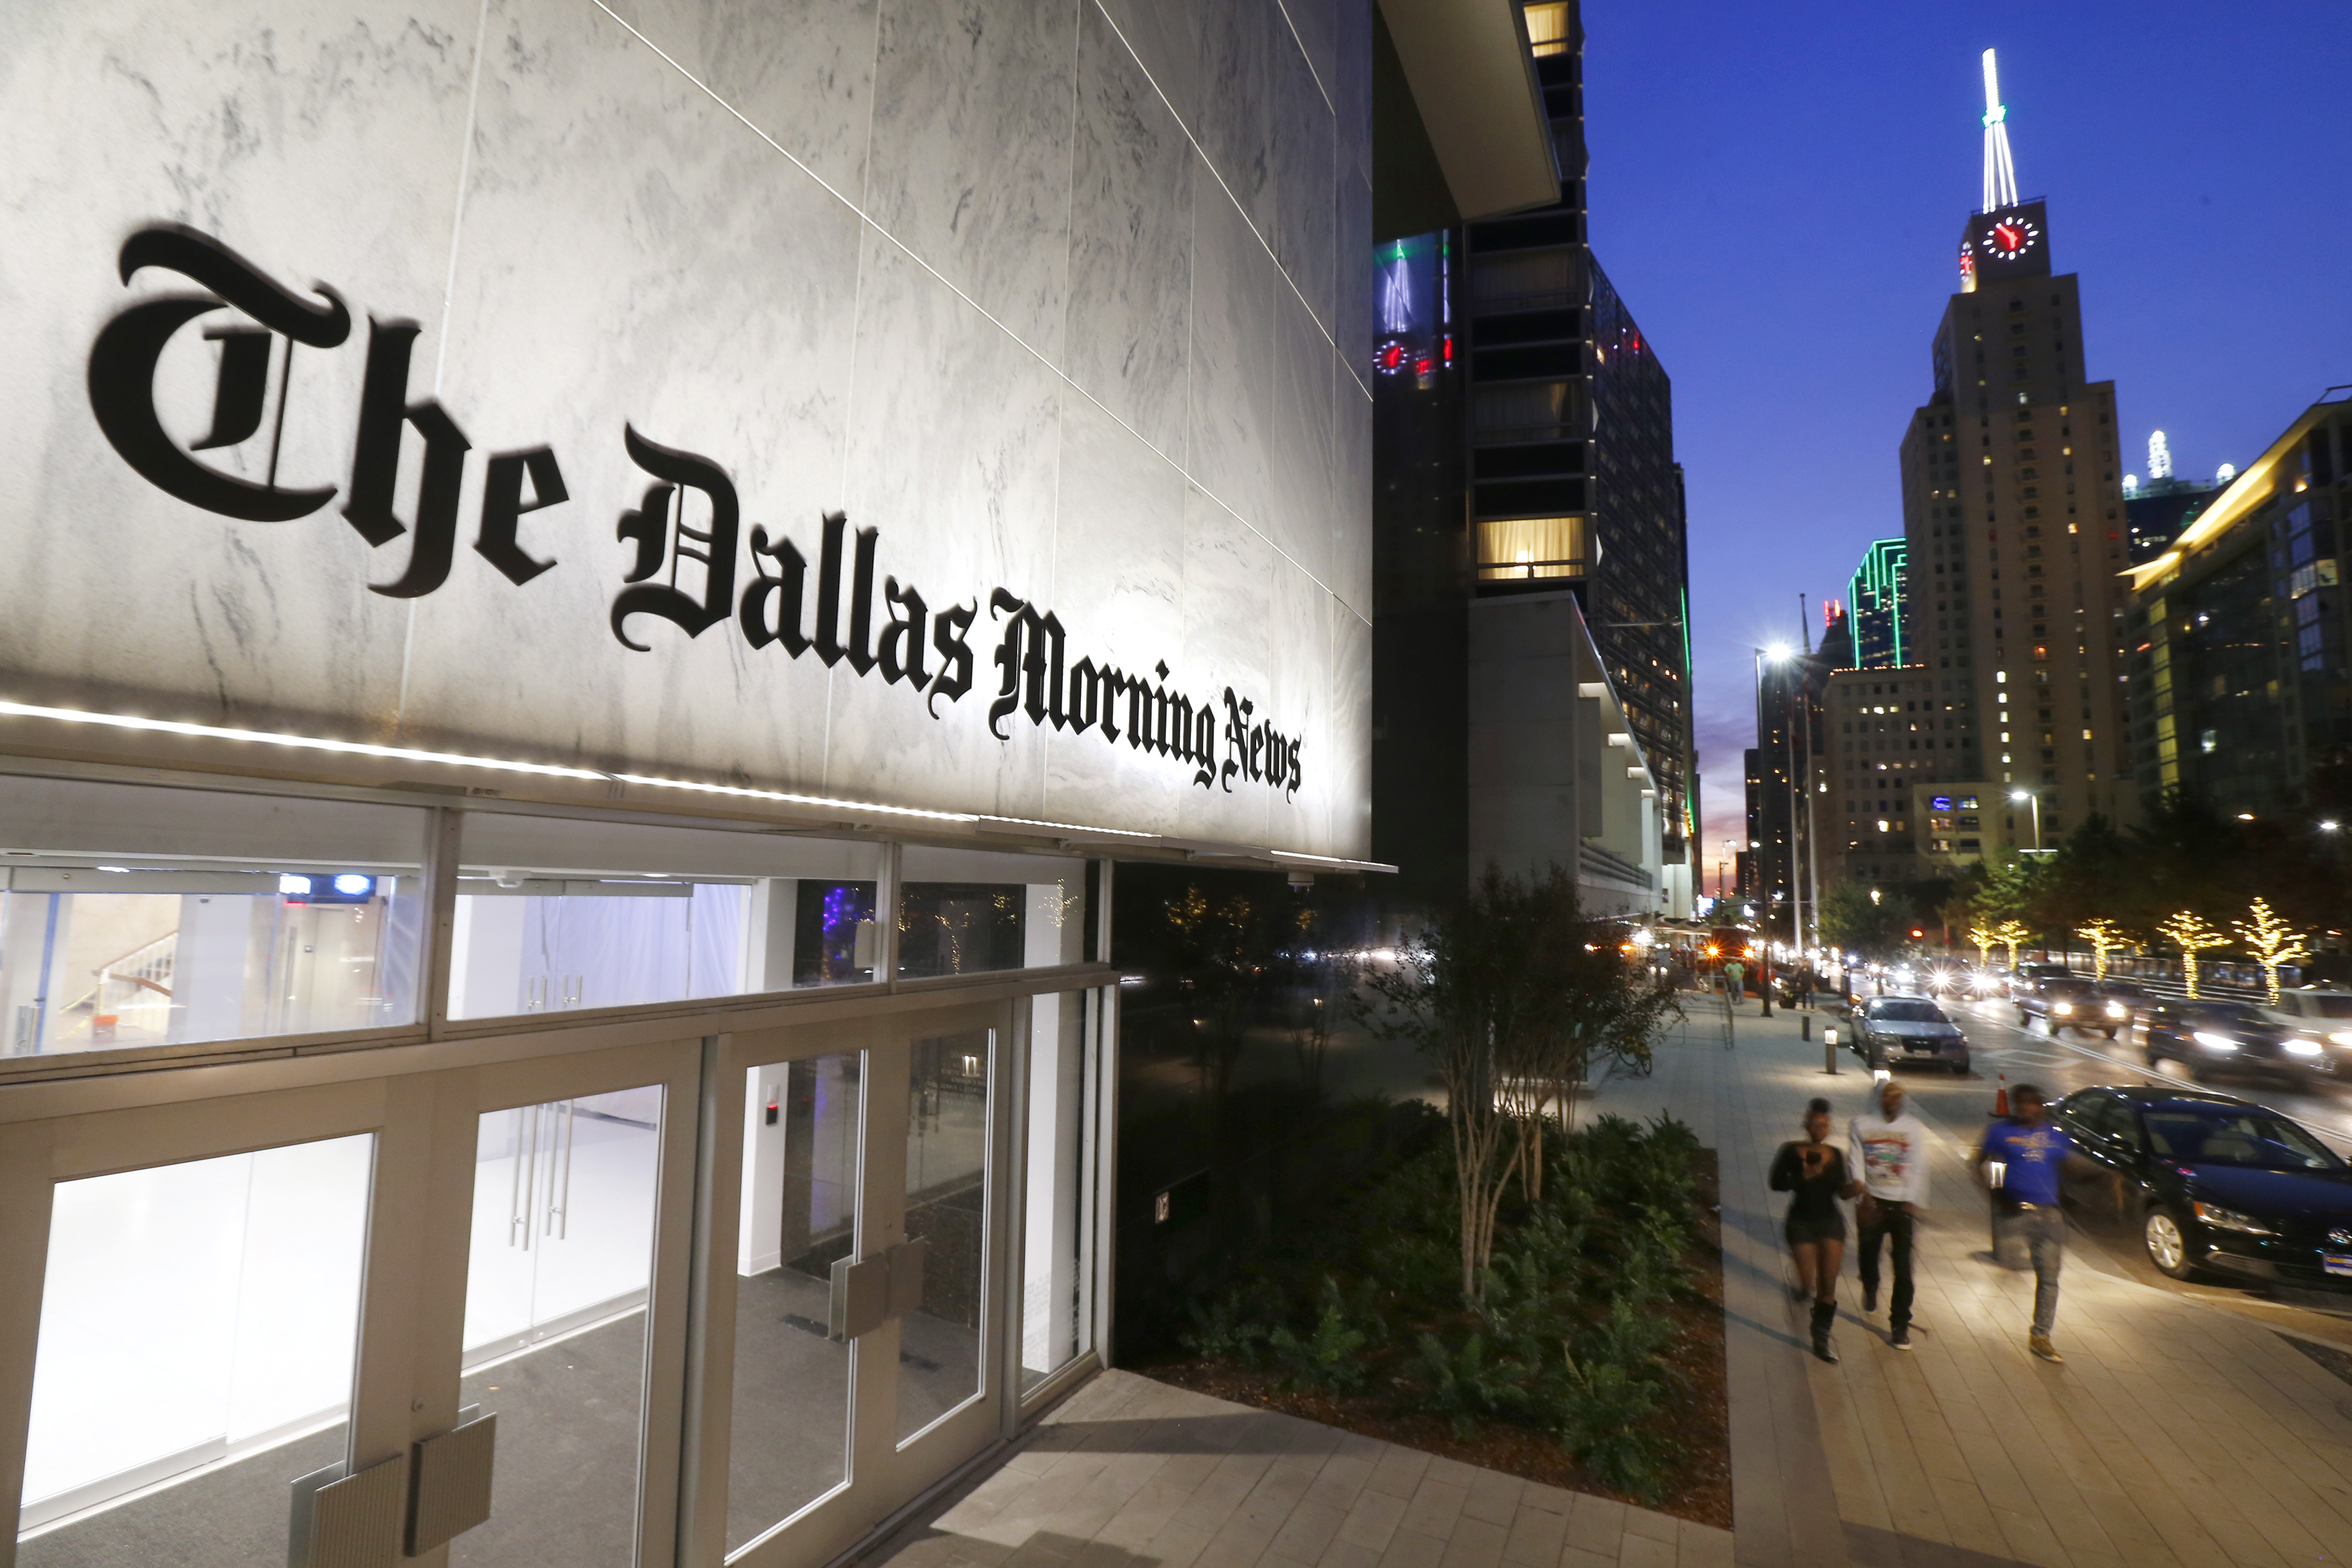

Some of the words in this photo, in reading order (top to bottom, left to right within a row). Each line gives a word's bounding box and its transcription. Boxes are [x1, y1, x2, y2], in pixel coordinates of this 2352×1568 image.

[88, 225, 570, 599] The
[611, 423, 978, 720] Dallas
[989, 588, 1217, 790] Morning
[1221, 687, 1302, 804] News
